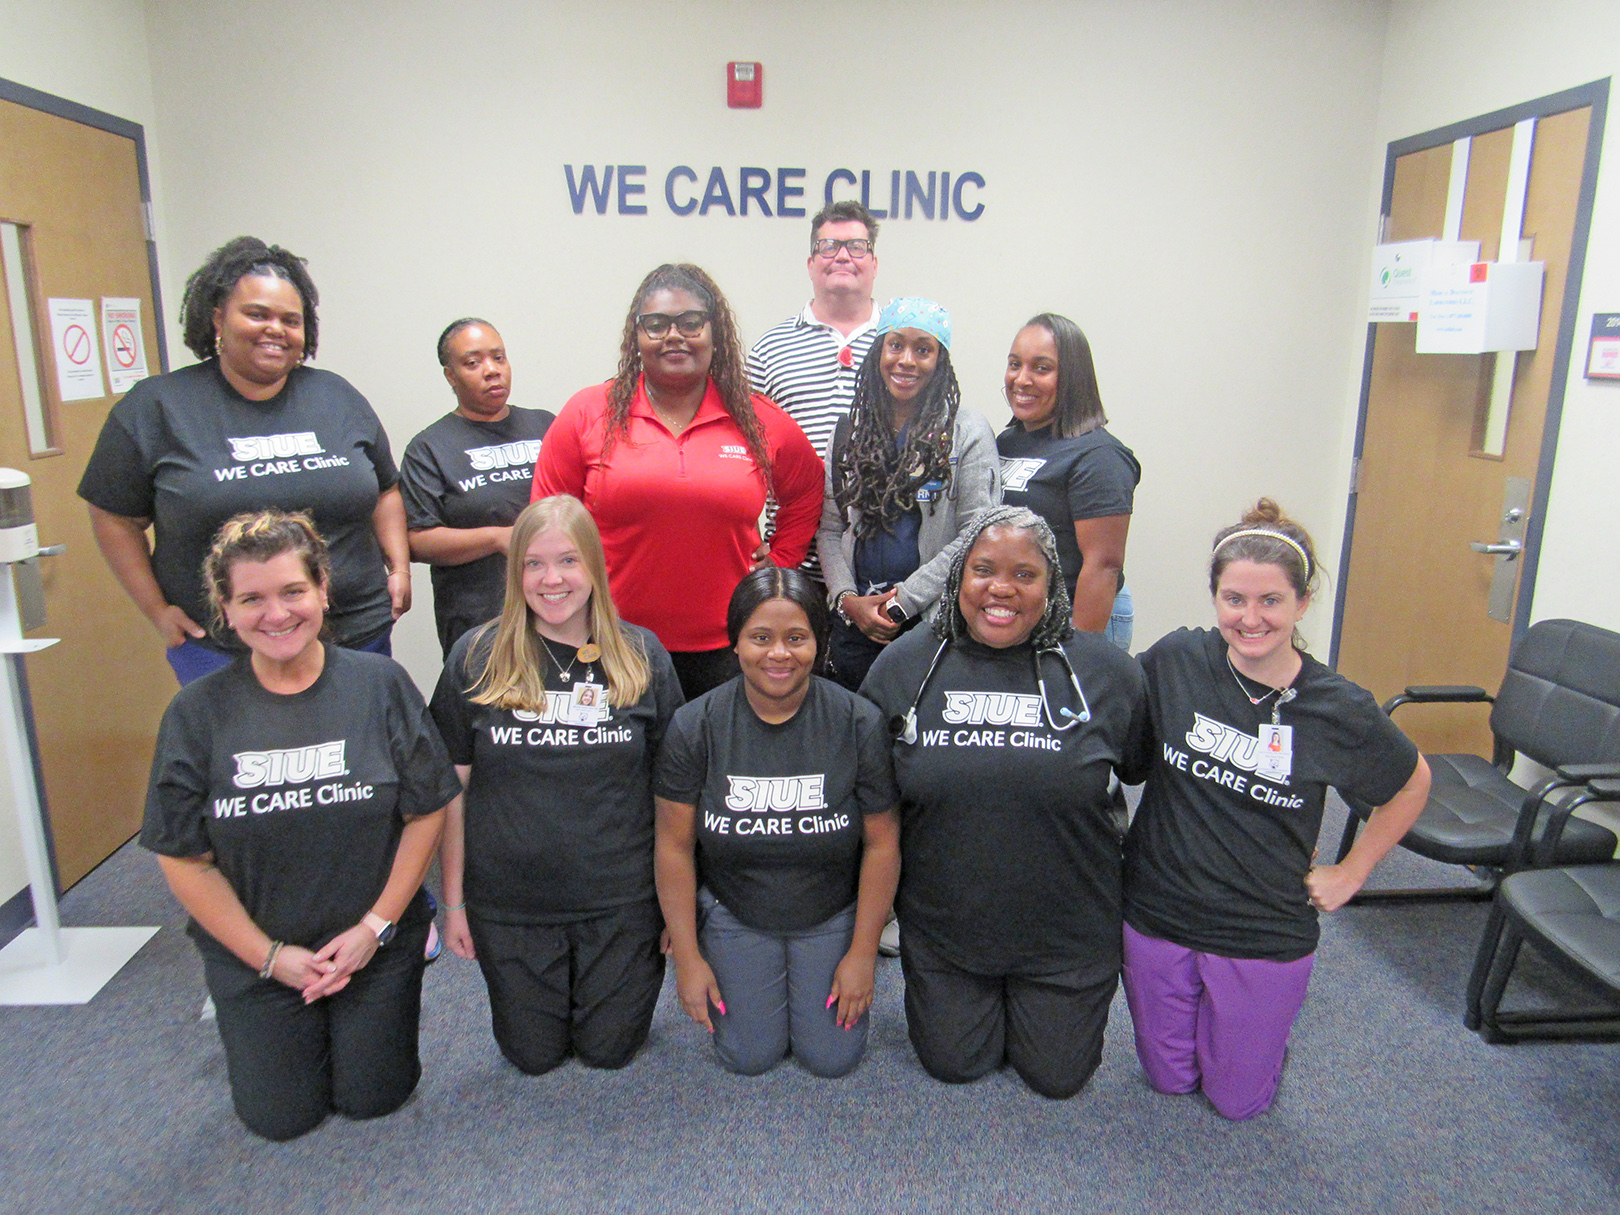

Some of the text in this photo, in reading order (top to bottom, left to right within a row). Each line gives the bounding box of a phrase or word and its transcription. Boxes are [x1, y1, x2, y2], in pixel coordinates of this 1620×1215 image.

[563, 163, 986, 221] WE CARE CLINIC
[227, 431, 322, 461] SIUE
[214, 455, 350, 482] WE CARE Clinic
[458, 468, 533, 492] WE CARE
[942, 691, 1043, 727] SIUE
[490, 725, 633, 746] WE CARE Clinic
[922, 729, 1062, 752] WE CARE Clinic
[1185, 712, 1287, 784] SIU
[232, 739, 346, 788] SIUE
[1163, 742, 1305, 809] WE CARE Clinic
[214, 781, 374, 819] WE CARE Clinic
[724, 773, 825, 812] SIUE
[704, 810, 850, 835] WE CARE Clinic
